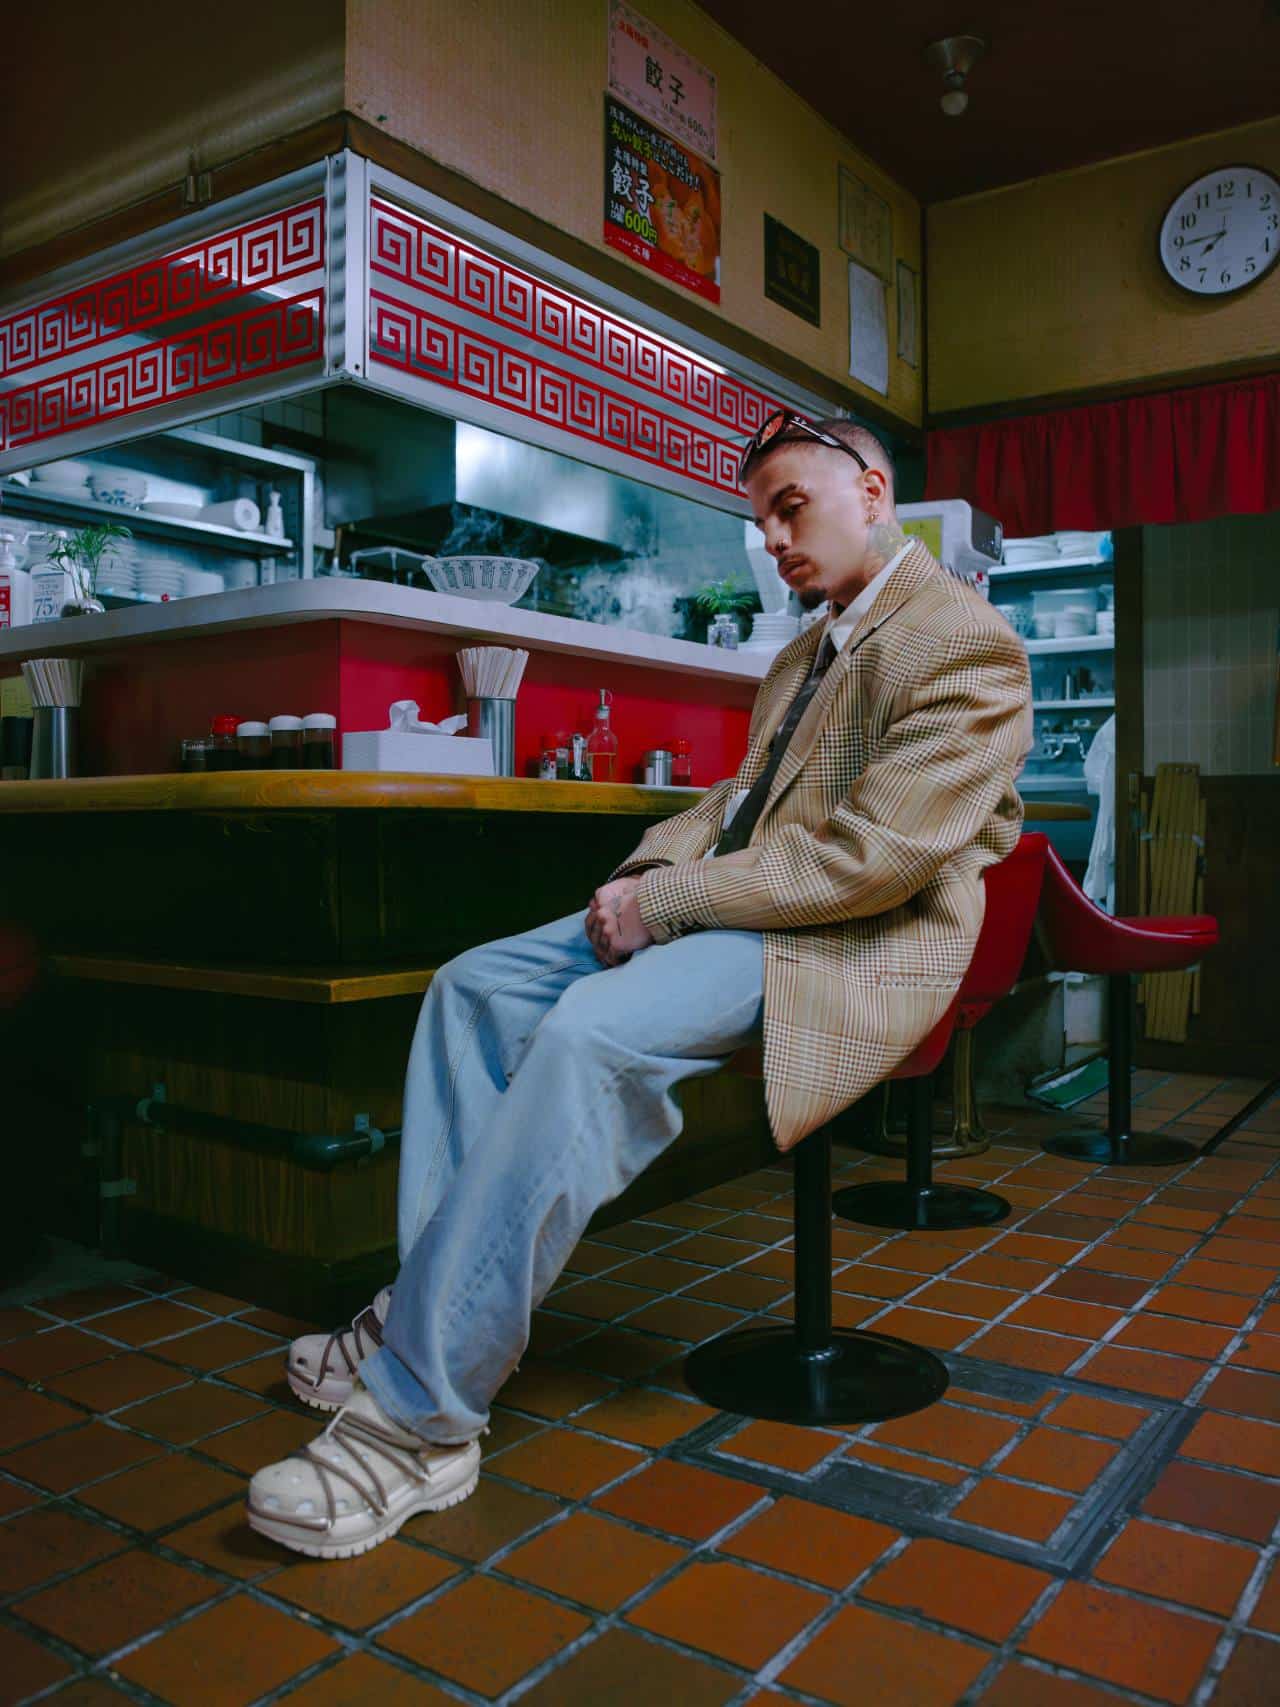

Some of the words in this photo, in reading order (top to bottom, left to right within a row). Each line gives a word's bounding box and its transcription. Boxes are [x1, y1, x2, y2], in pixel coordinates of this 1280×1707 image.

[645, 55, 686, 105] 餃子
[610, 160, 656, 214] 餃子
[1216, 180, 1234, 199] 12
[1195, 191, 1210, 210] 11
[1259, 193, 1271, 211] 2
[1181, 211, 1197, 231] 10
[1267, 213, 1279, 231] 3
[1179, 255, 1191, 273] 8
[1244, 256, 1256, 272] 5
[1197, 267, 1207, 285] 7
[1219, 268, 1231, 286] 6
